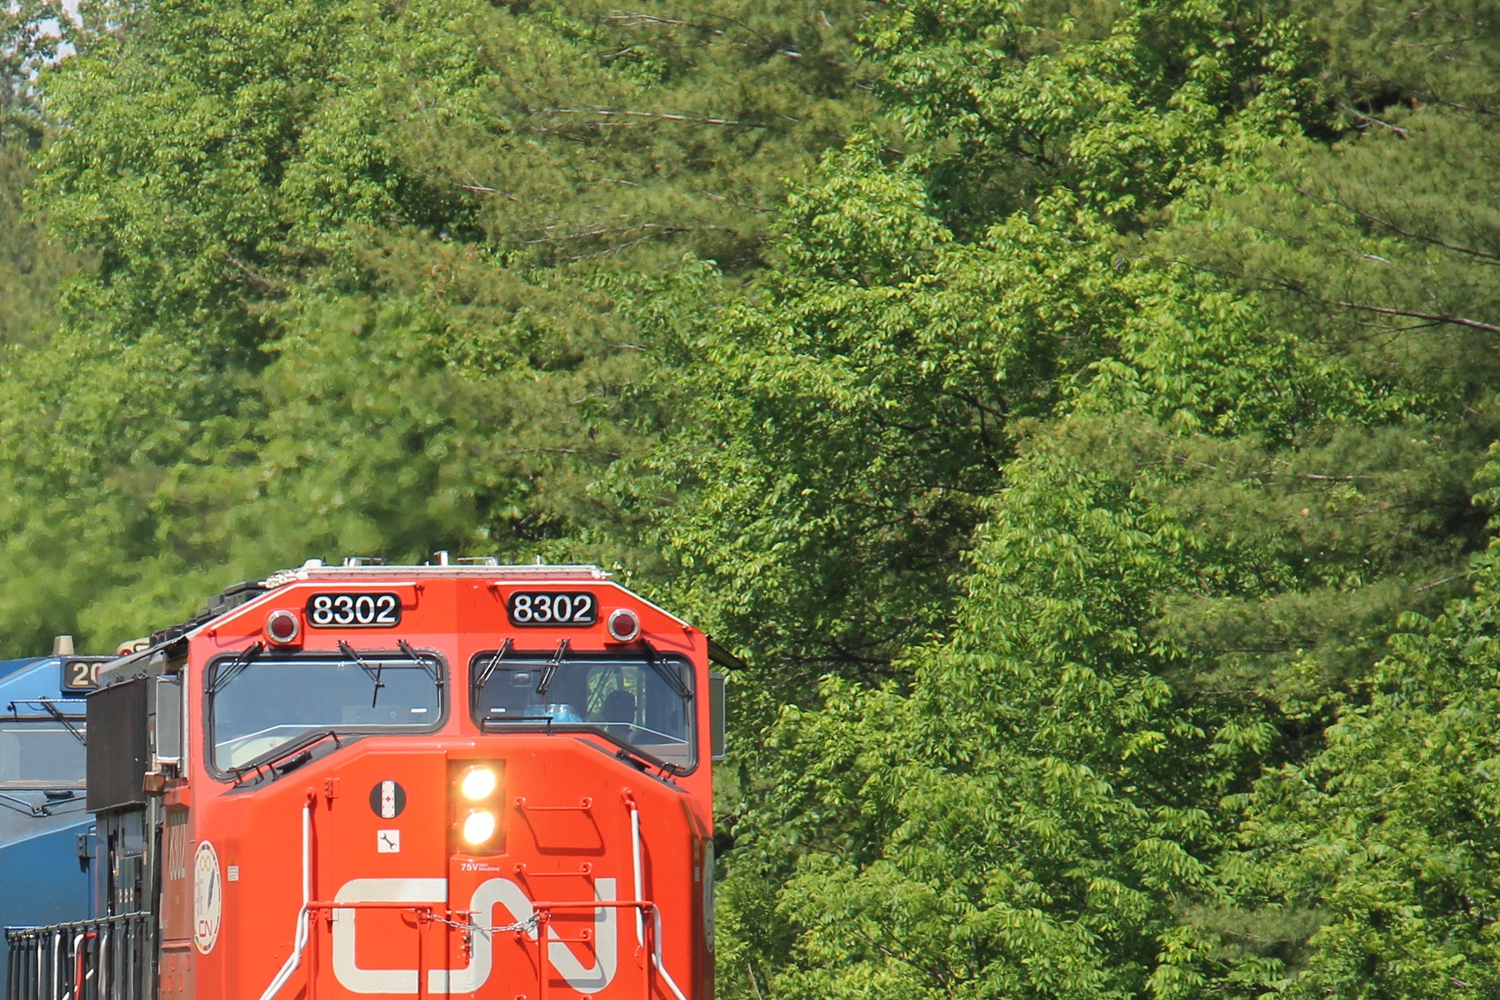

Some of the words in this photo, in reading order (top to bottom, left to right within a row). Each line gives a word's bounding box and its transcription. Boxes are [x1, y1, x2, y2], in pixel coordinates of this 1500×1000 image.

[313, 595, 396, 624] 8302
[513, 594, 592, 622] 8302
[461, 863, 478, 871] 75V
[198, 920, 212, 937] CN
[332, 877, 617, 994] CN
